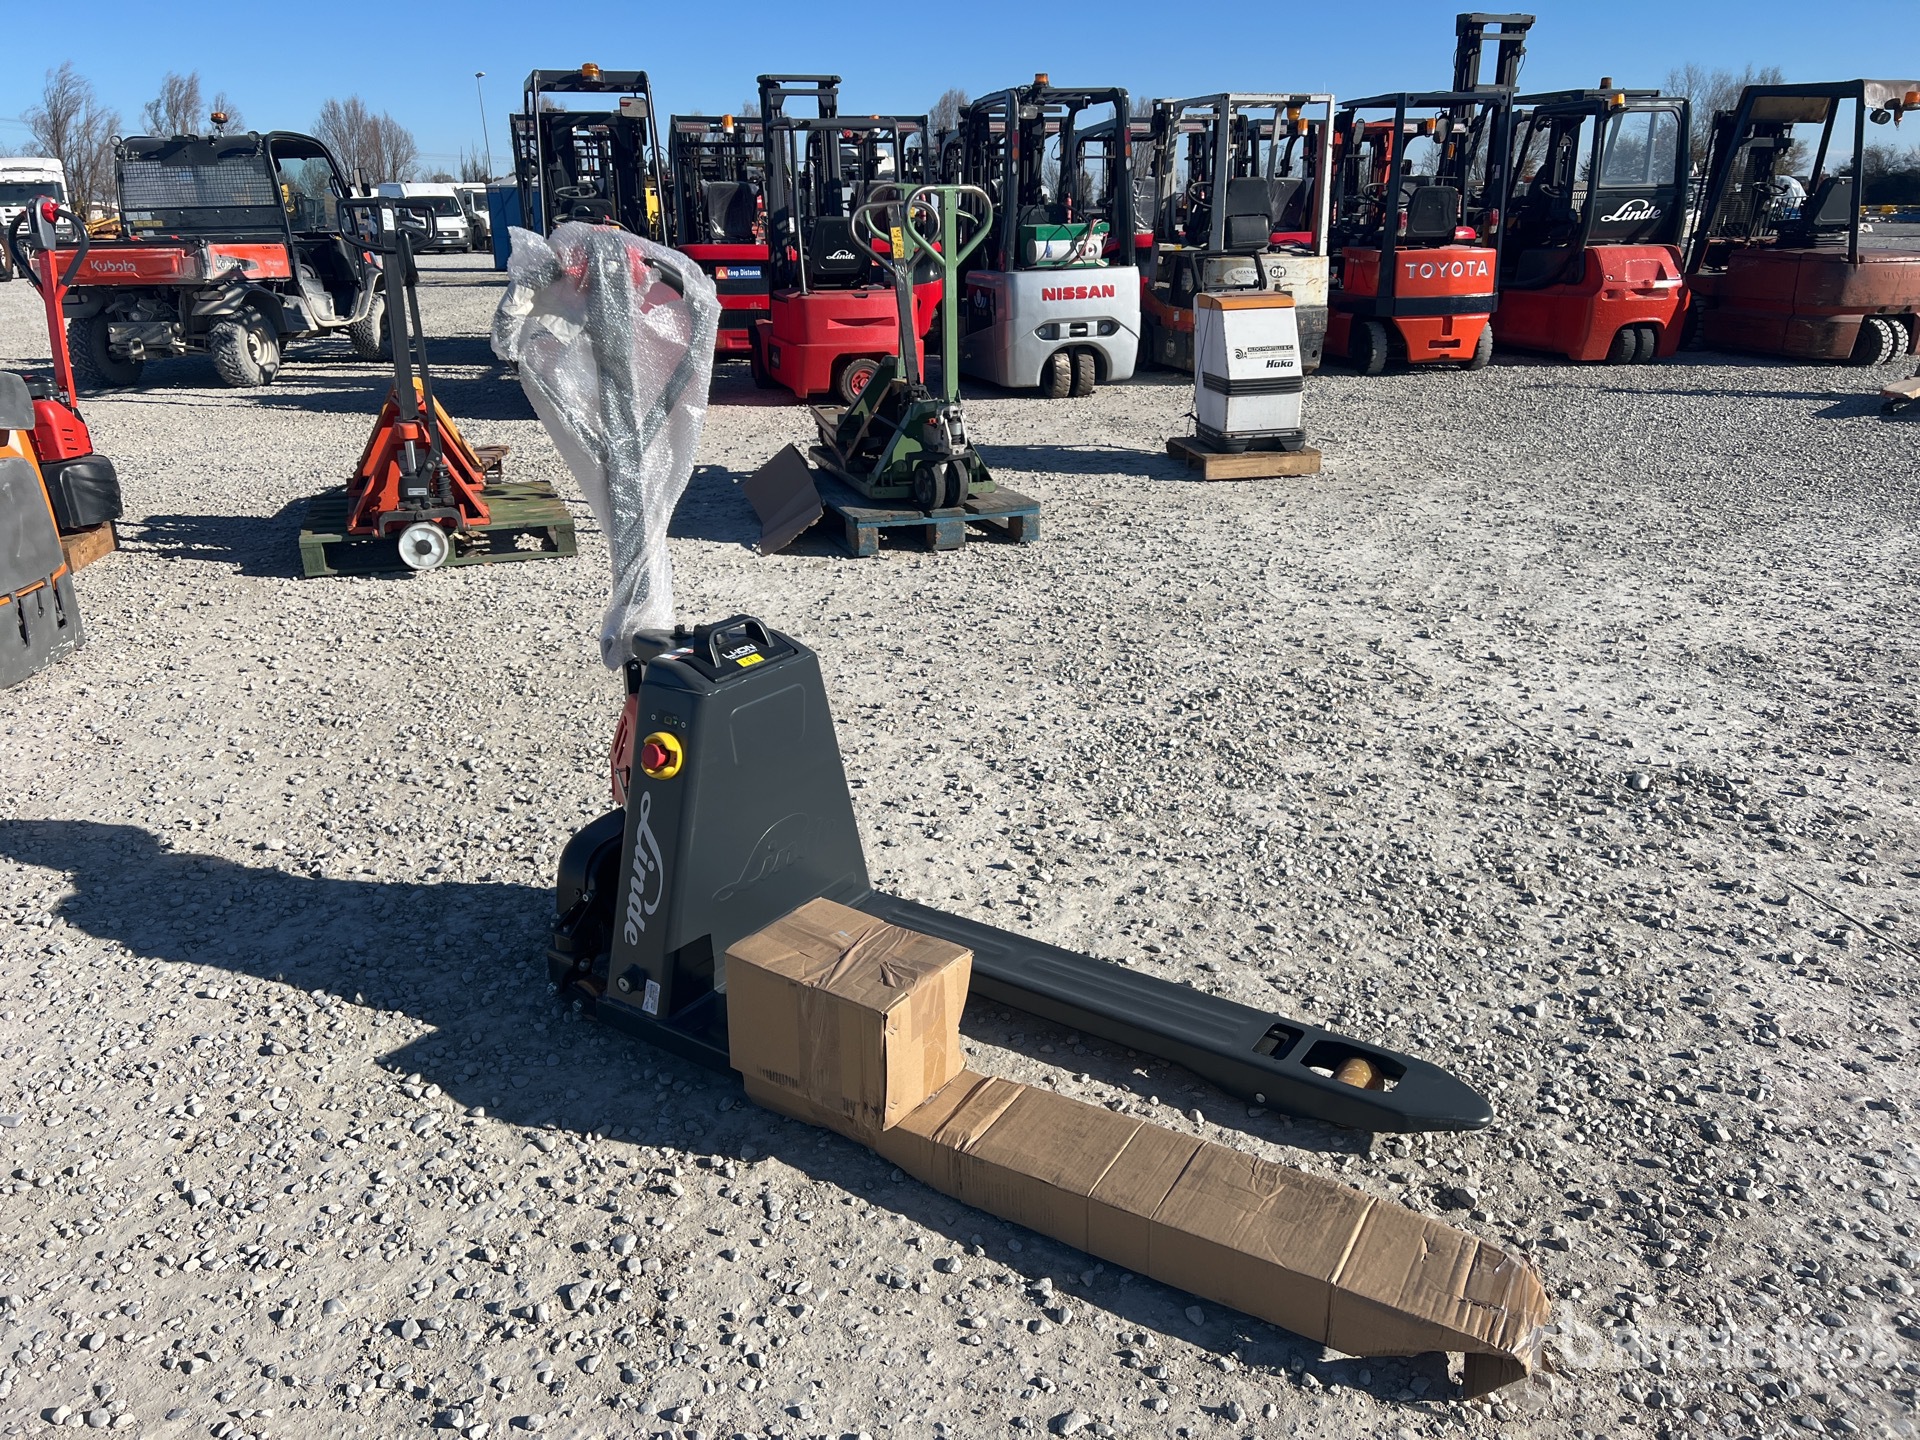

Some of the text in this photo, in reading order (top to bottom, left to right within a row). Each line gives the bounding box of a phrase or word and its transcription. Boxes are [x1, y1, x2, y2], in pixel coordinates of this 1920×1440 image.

[1600, 199, 1661, 222] Linde
[826, 249, 856, 260] Linde
[90, 259, 136, 272] Kubota
[216, 259, 243, 271] Kubota
[1405, 259, 1489, 279] TOYOTA
[727, 268, 761, 277] Keep Distance
[1042, 284, 1115, 301] NISSAN
[1266, 359, 1294, 368] Hako
[624, 790, 664, 946] Linde
